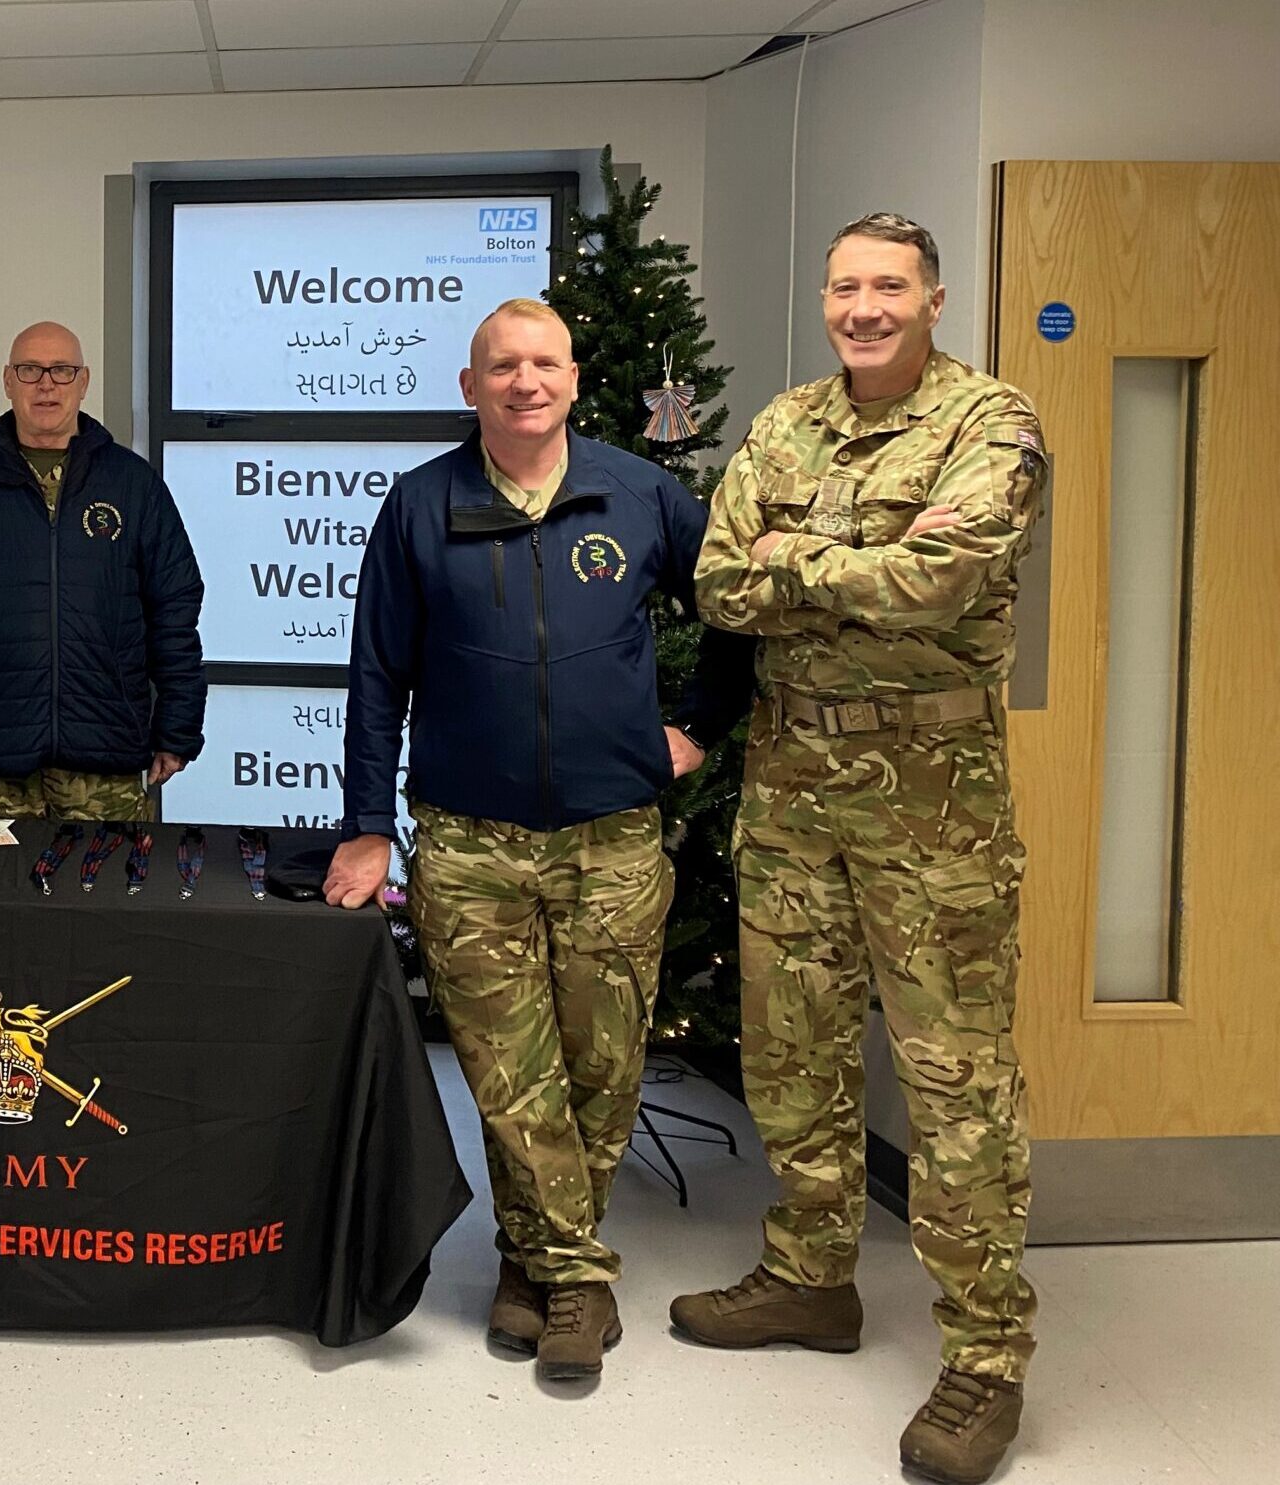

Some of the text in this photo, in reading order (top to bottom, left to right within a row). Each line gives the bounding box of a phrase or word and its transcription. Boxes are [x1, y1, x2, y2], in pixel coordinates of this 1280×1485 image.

[480, 209, 536, 231] NHS
[486, 237, 536, 250] Bolton
[425, 253, 537, 265] NHS Foundation Trust
[254, 267, 464, 305] Welcome
[360, 327, 427, 356] خوش
[284, 517, 373, 546] Wita
[250, 562, 358, 600] Welc
[144, 1221, 285, 1266] RESERVE
